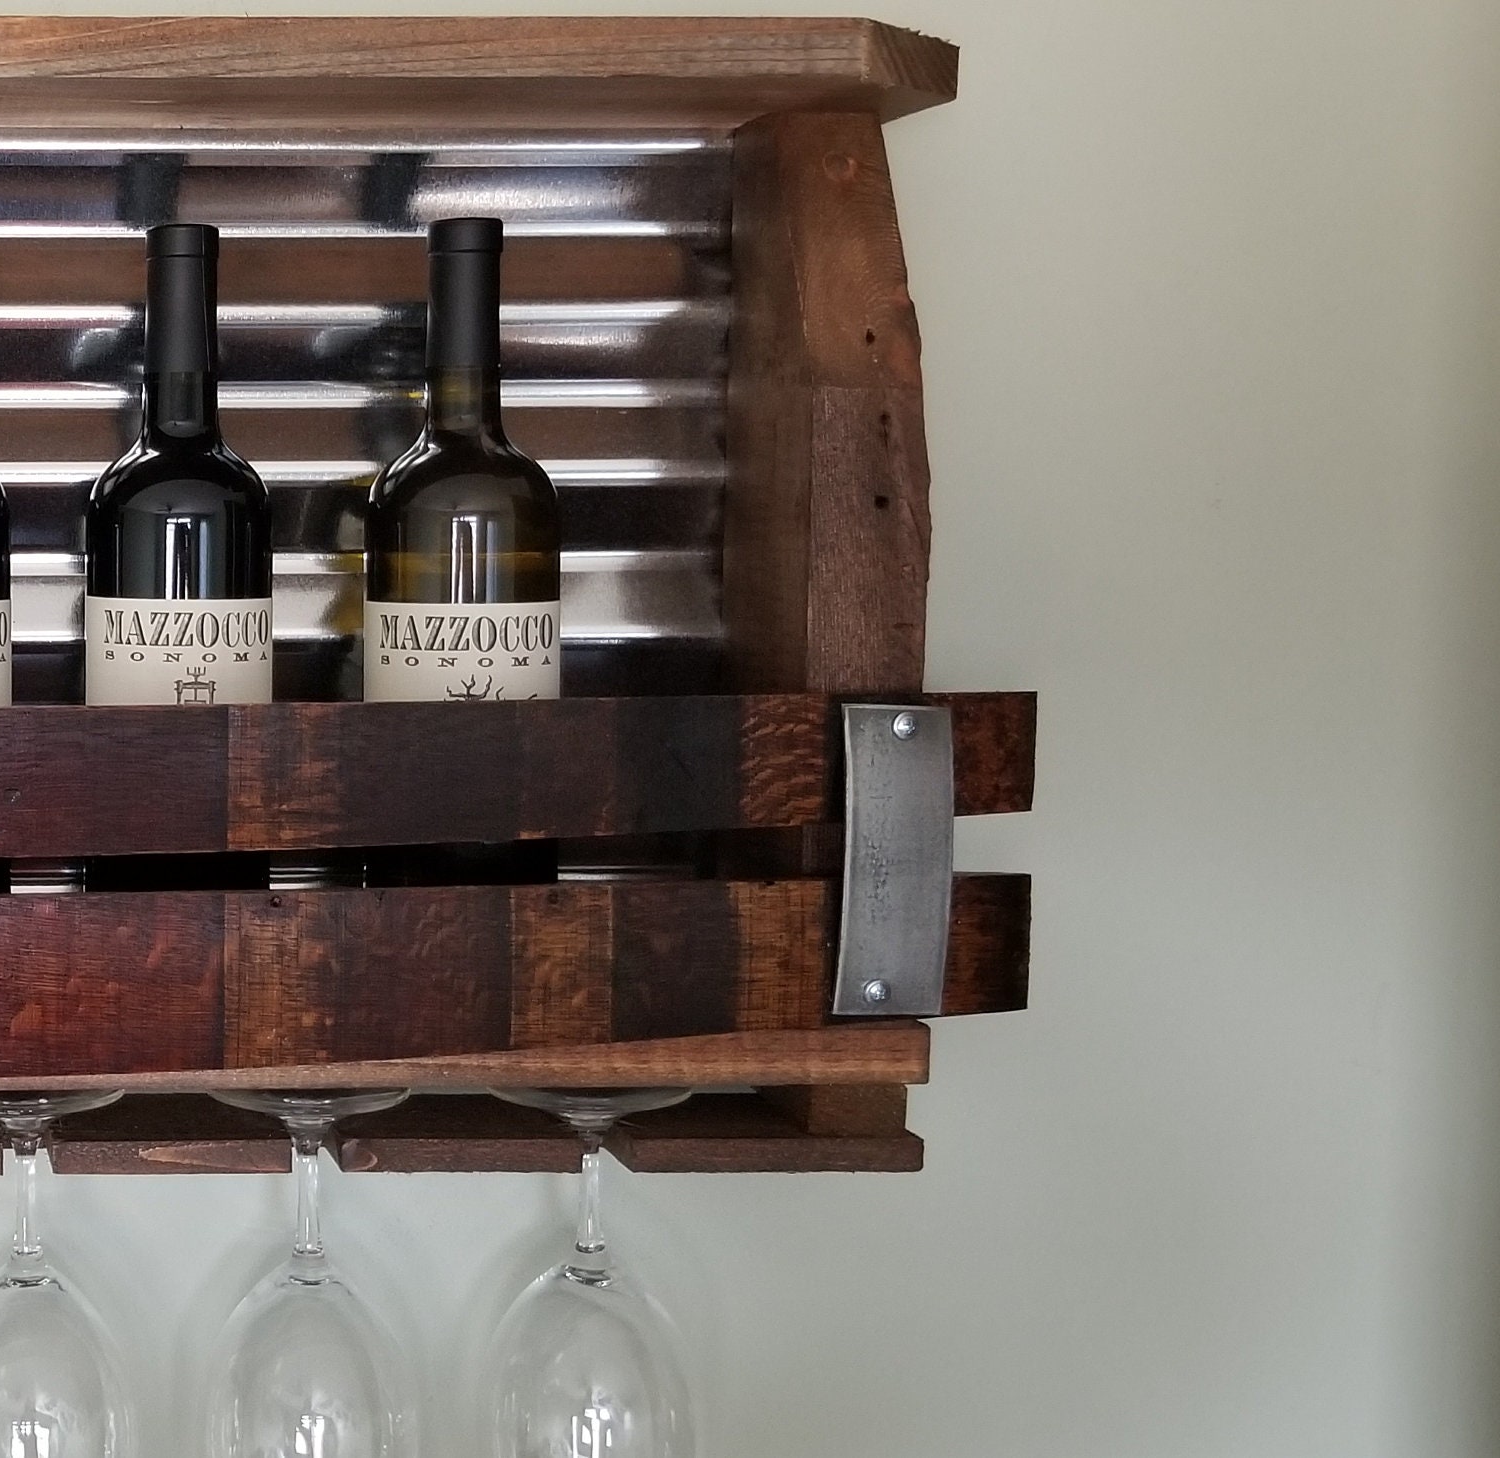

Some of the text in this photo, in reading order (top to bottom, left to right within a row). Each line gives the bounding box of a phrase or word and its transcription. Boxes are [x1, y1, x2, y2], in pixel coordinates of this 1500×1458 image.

[103, 609, 269, 648] MAZZOCCO
[379, 613, 554, 652] MAZZOCCO
[105, 650, 268, 663] SONOMA
[380, 655, 552, 668] SONOMA
